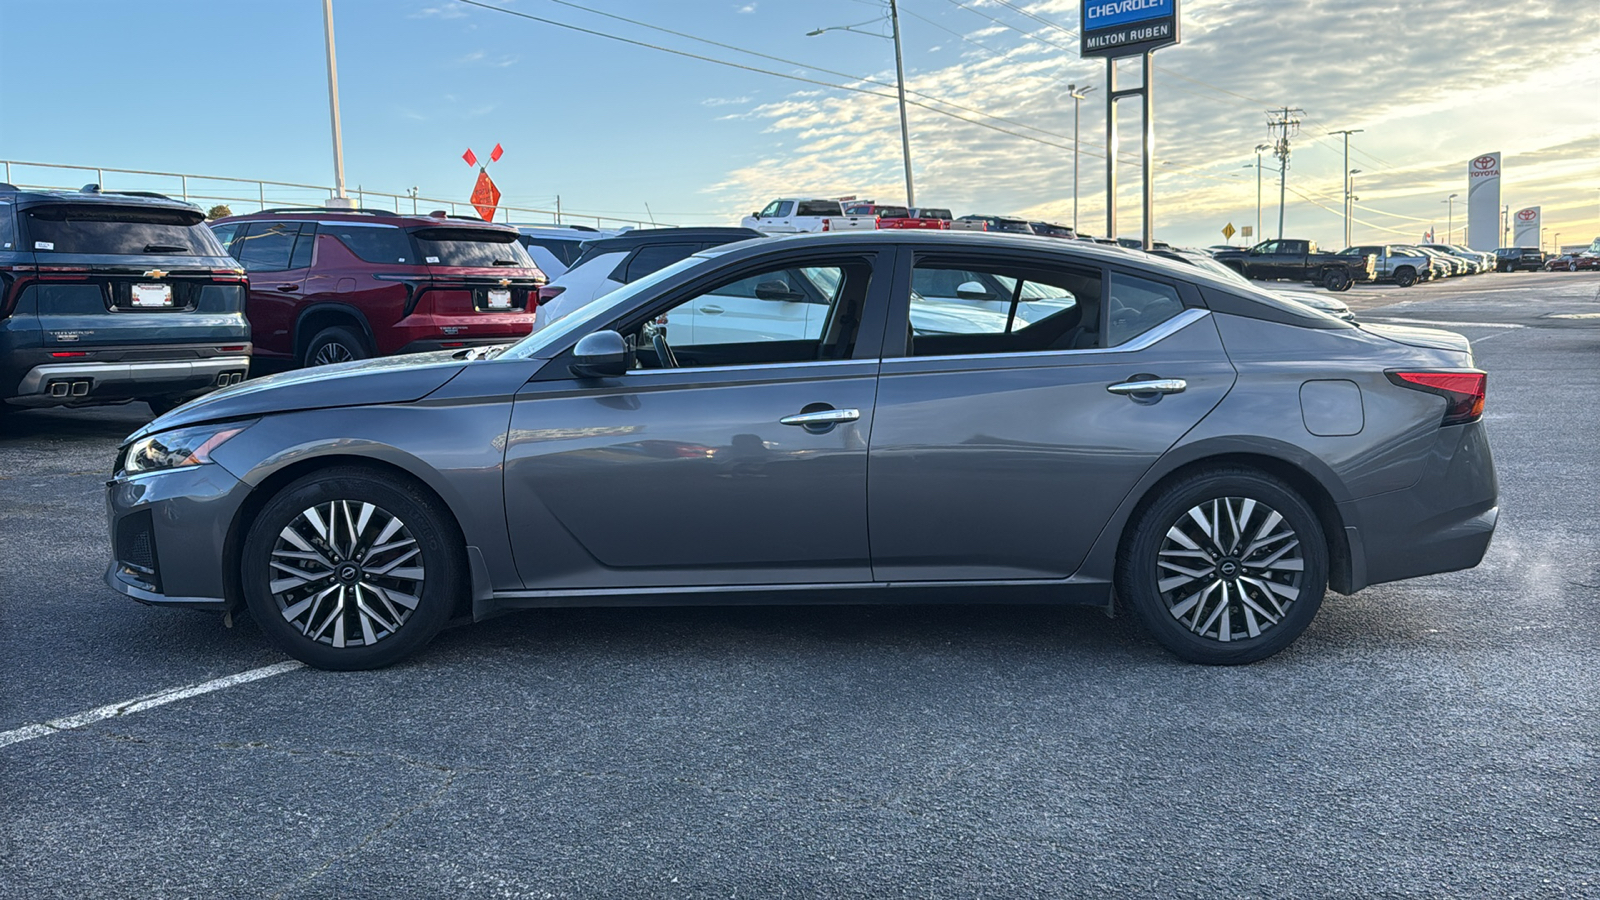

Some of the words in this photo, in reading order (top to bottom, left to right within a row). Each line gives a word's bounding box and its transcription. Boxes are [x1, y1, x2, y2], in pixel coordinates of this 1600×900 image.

[1087, 32, 1125, 48] MILTON
[1130, 25, 1168, 40] RUBEN
[1470, 170, 1499, 178] TOYOTA
